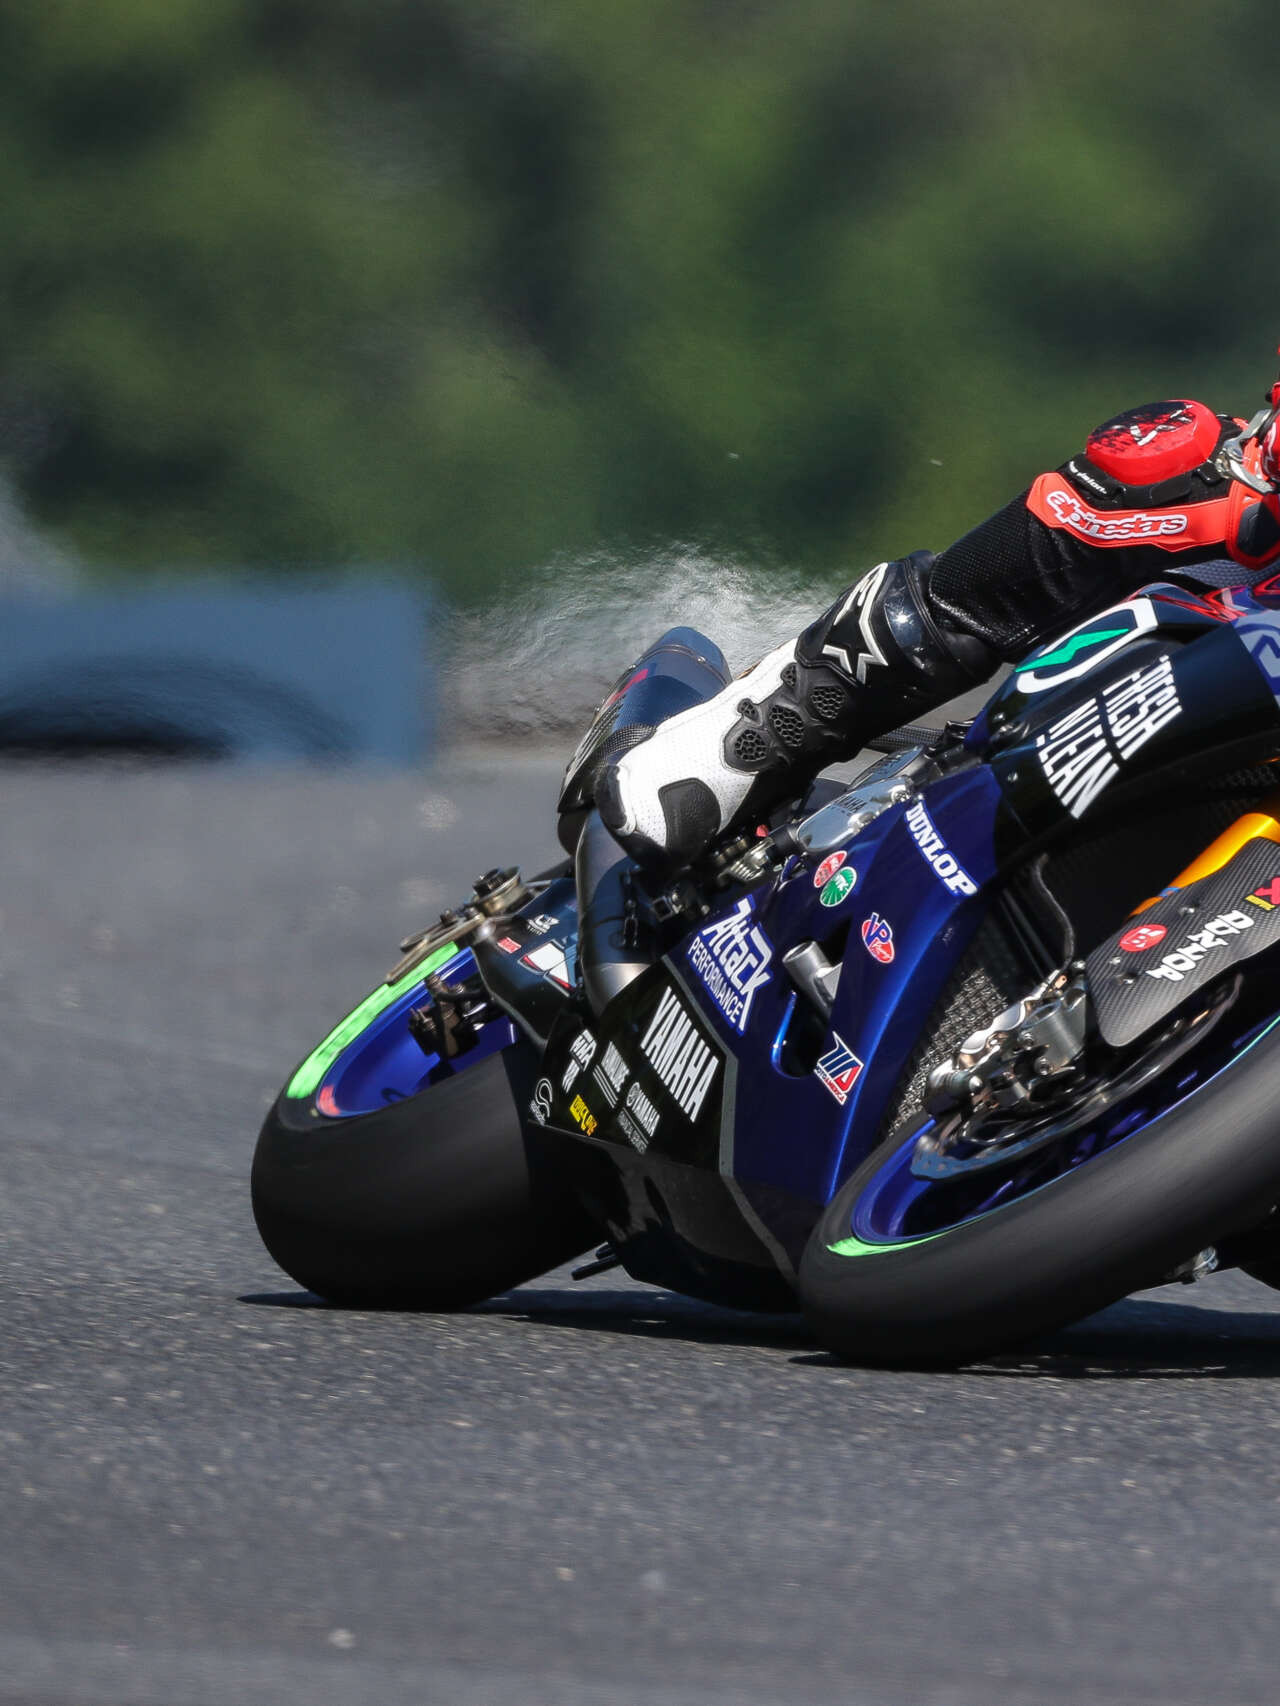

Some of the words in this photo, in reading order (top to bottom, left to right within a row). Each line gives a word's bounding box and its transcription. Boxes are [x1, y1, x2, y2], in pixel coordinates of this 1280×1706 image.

[1046, 490, 1188, 540] alpinestars
[1102, 655, 1183, 760] FRESH
[1038, 714, 1120, 820] LEAN
[905, 801, 979, 896] DUNLOP
[688, 935, 744, 1024] PERFORMANCE
[701, 897, 773, 1032] Attack
[865, 913, 893, 946] VP
[640, 985, 720, 1124] YAMAHA
